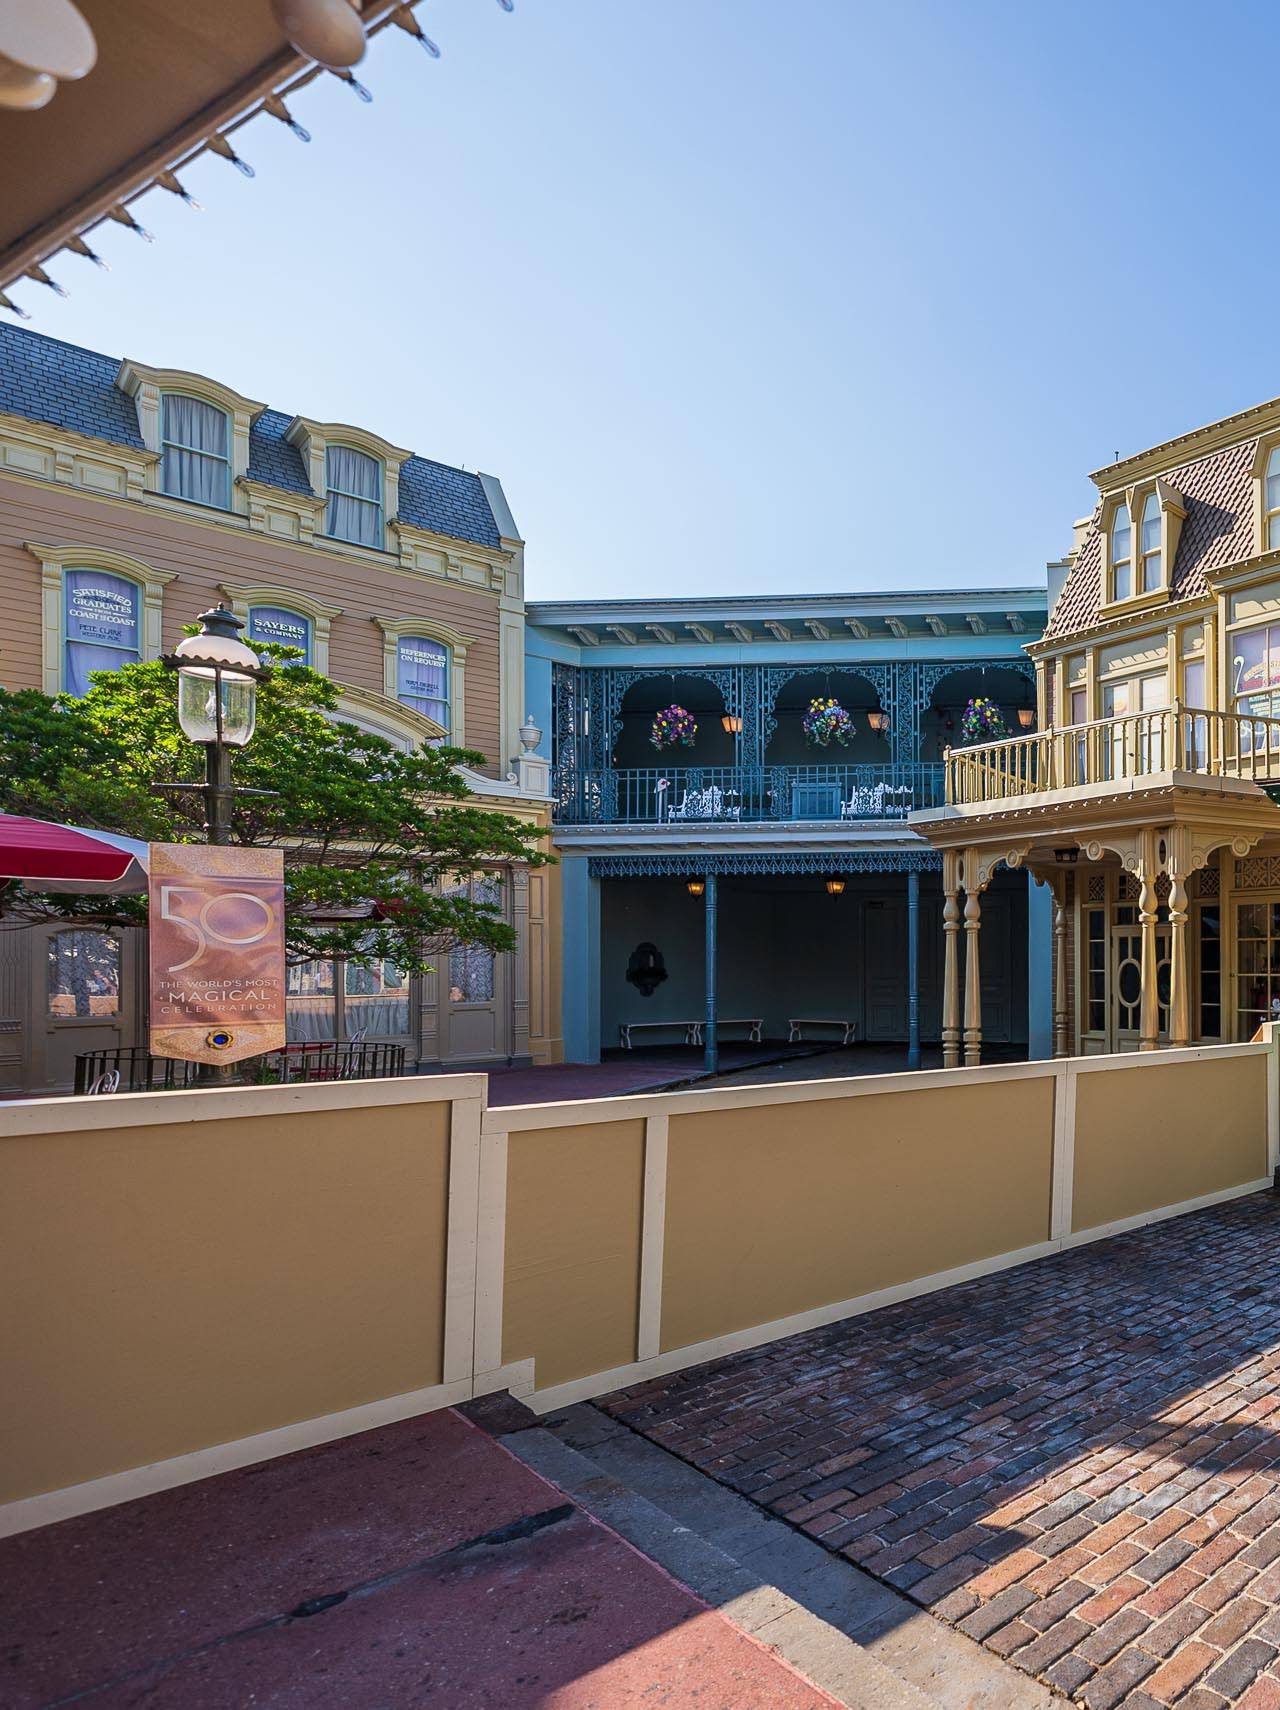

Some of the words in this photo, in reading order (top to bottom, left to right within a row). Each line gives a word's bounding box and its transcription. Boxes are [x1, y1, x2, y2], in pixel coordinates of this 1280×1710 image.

[72, 588, 132, 606] SATISFIED
[72, 597, 132, 614] GRADUATES
[69, 608, 99, 621] COAST
[107, 616, 136, 627] COAST
[254, 618, 305, 635] SAYERS
[264, 629, 303, 640] COMPANY
[400, 647, 447, 662] REFERENCES
[413, 656, 446, 668] REQUEST
[161, 886, 275, 973] 50
[160, 981, 183, 989] THE
[187, 980, 242, 988] WORLD'S
[169, 989, 271, 1003] MAGICAL
[160, 1002, 276, 1014] CELEBRATION
